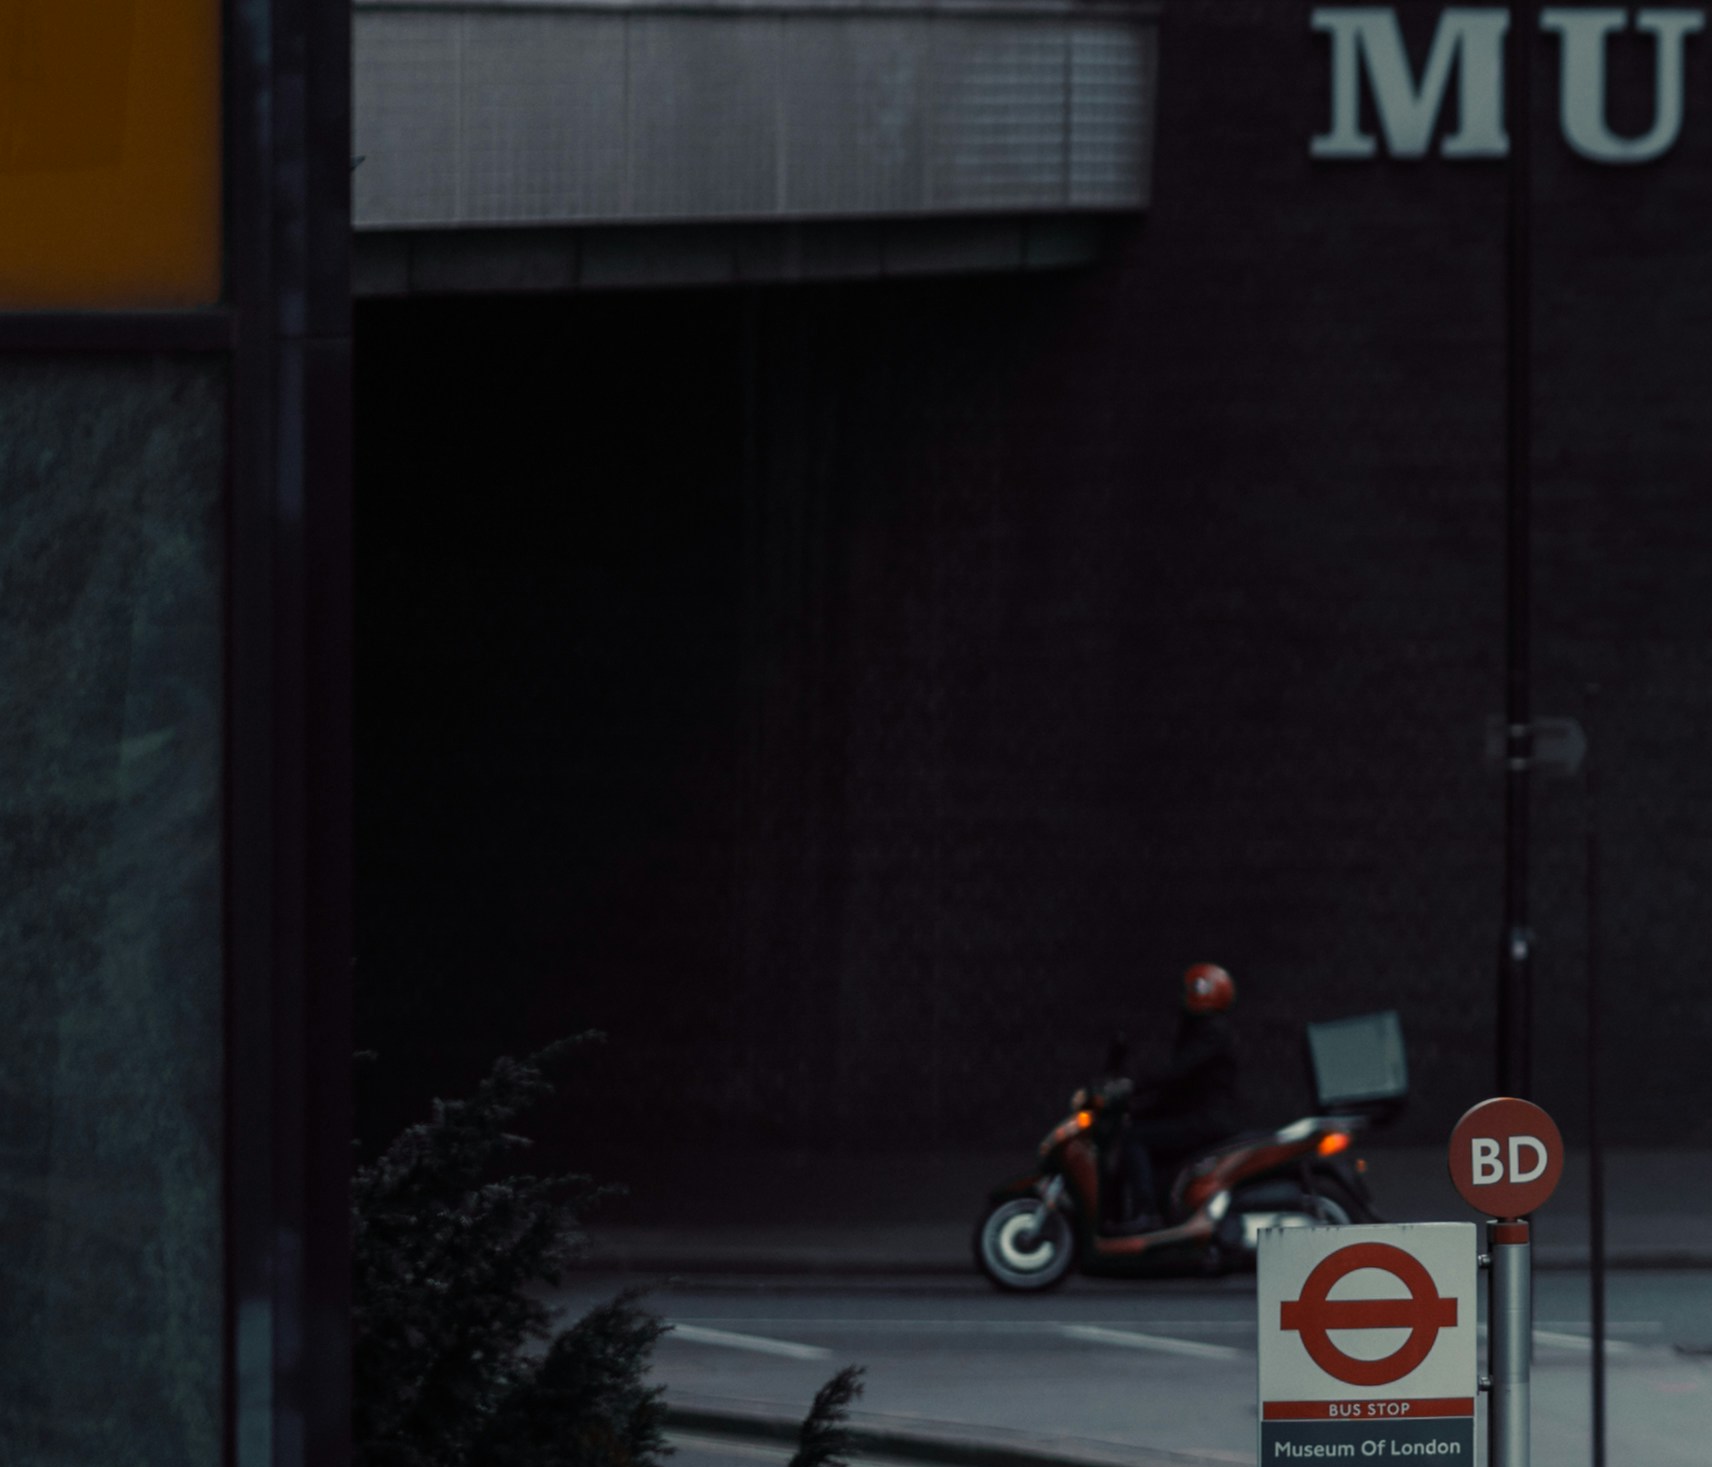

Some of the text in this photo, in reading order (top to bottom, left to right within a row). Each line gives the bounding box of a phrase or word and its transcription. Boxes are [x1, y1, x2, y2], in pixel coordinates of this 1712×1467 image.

[1471, 1135, 1548, 1185] BD
[1328, 1402, 1410, 1417] BUS STOP
[1274, 1439, 1461, 1458] Museum Of London
